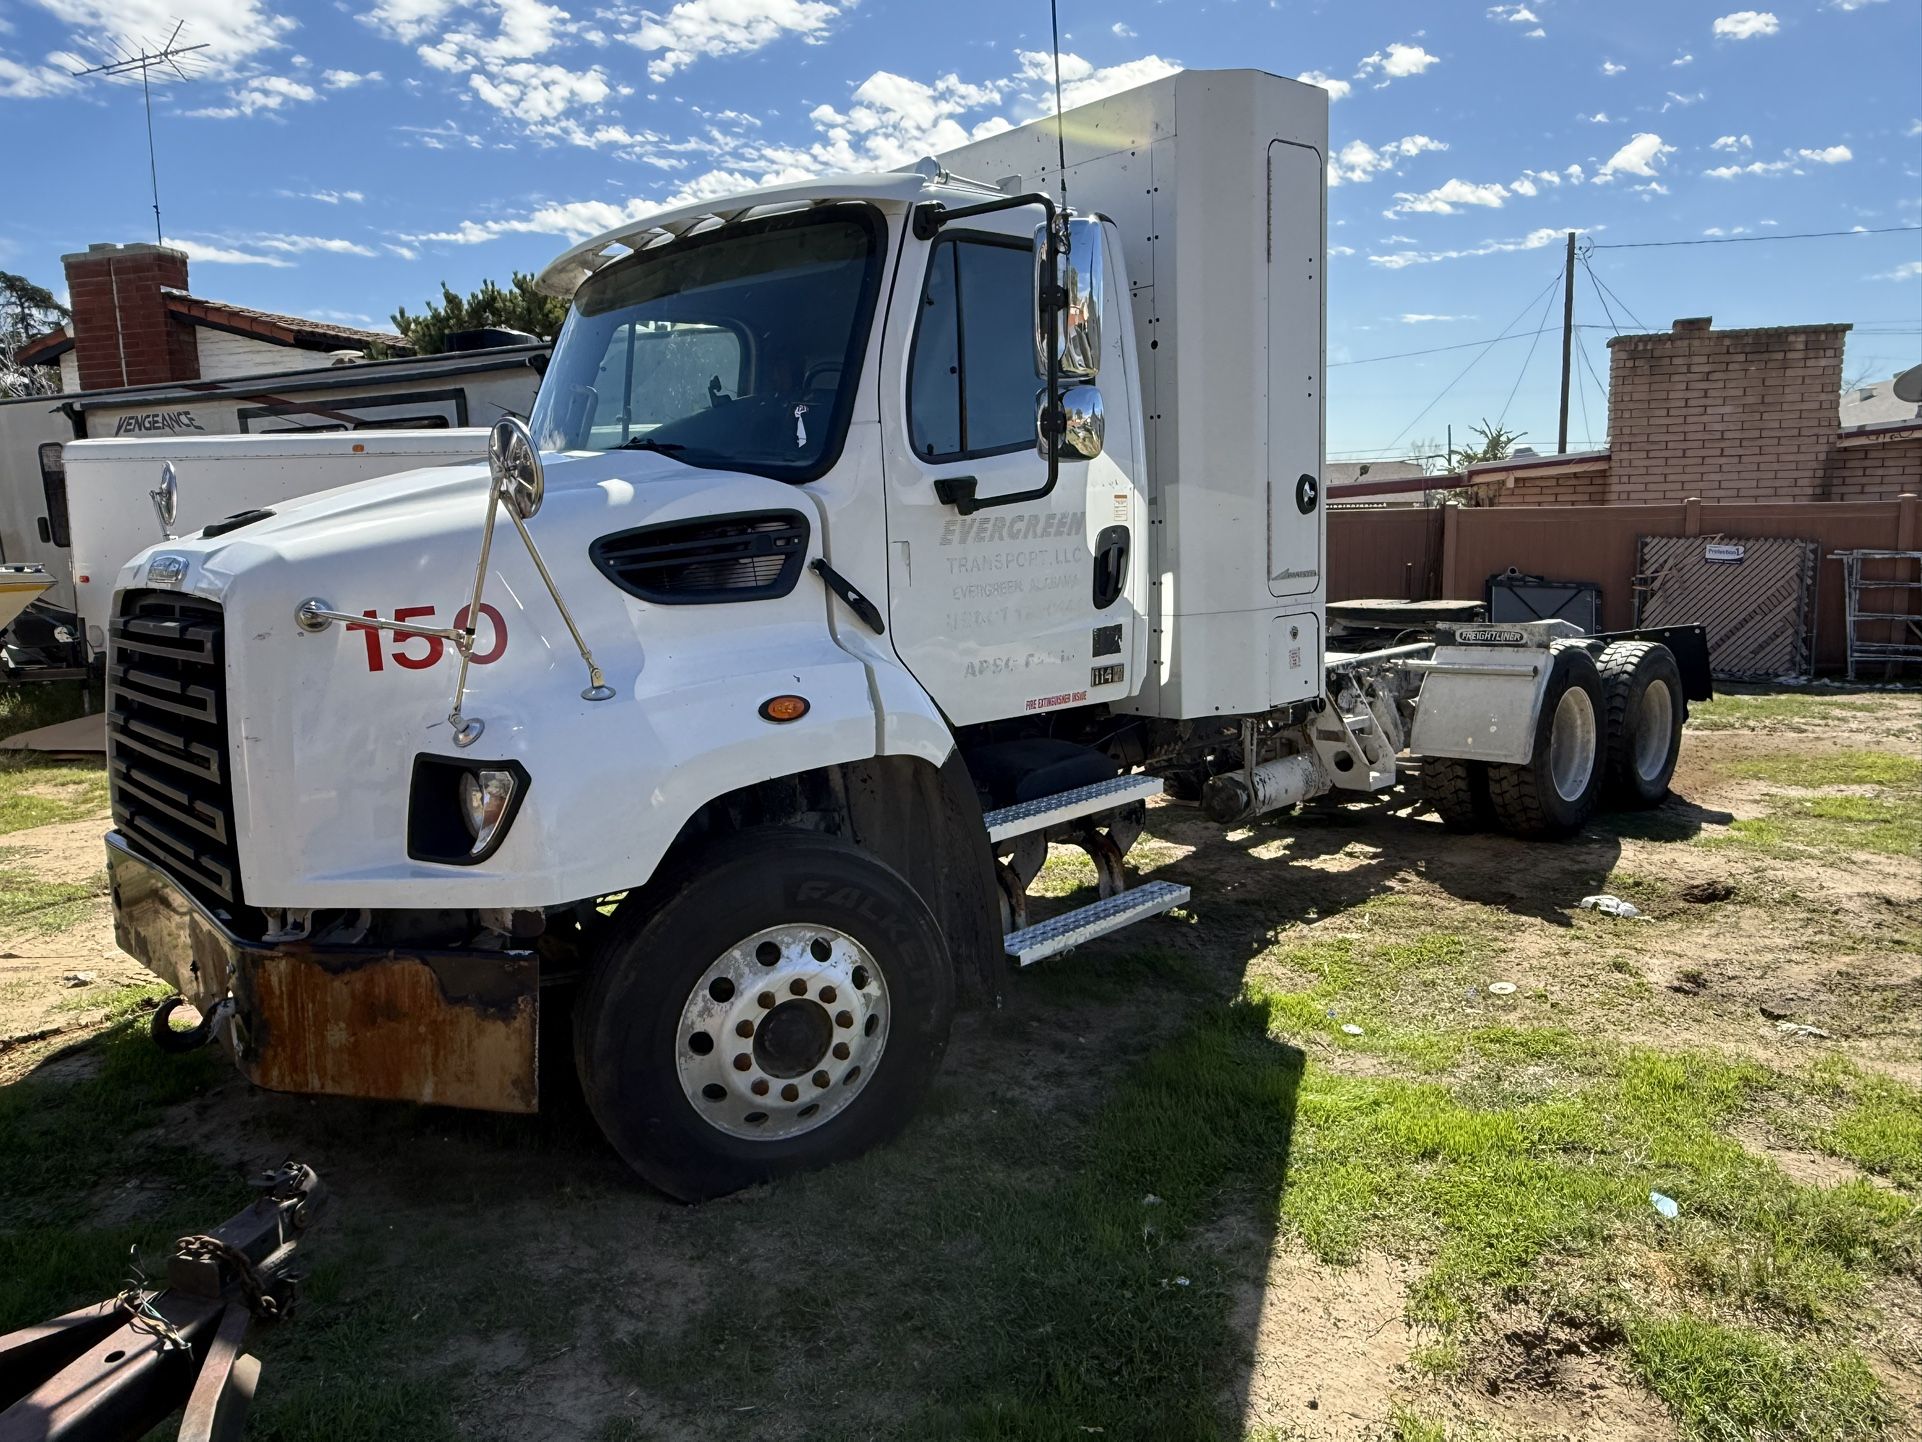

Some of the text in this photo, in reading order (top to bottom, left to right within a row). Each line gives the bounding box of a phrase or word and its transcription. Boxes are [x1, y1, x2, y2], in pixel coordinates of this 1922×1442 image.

[114, 410, 206, 438] VENGEANCE
[939, 512, 1086, 546] EVERGREEN
[346, 603, 508, 672] 150
[1461, 631, 1521, 642] FREIGHTLINER
